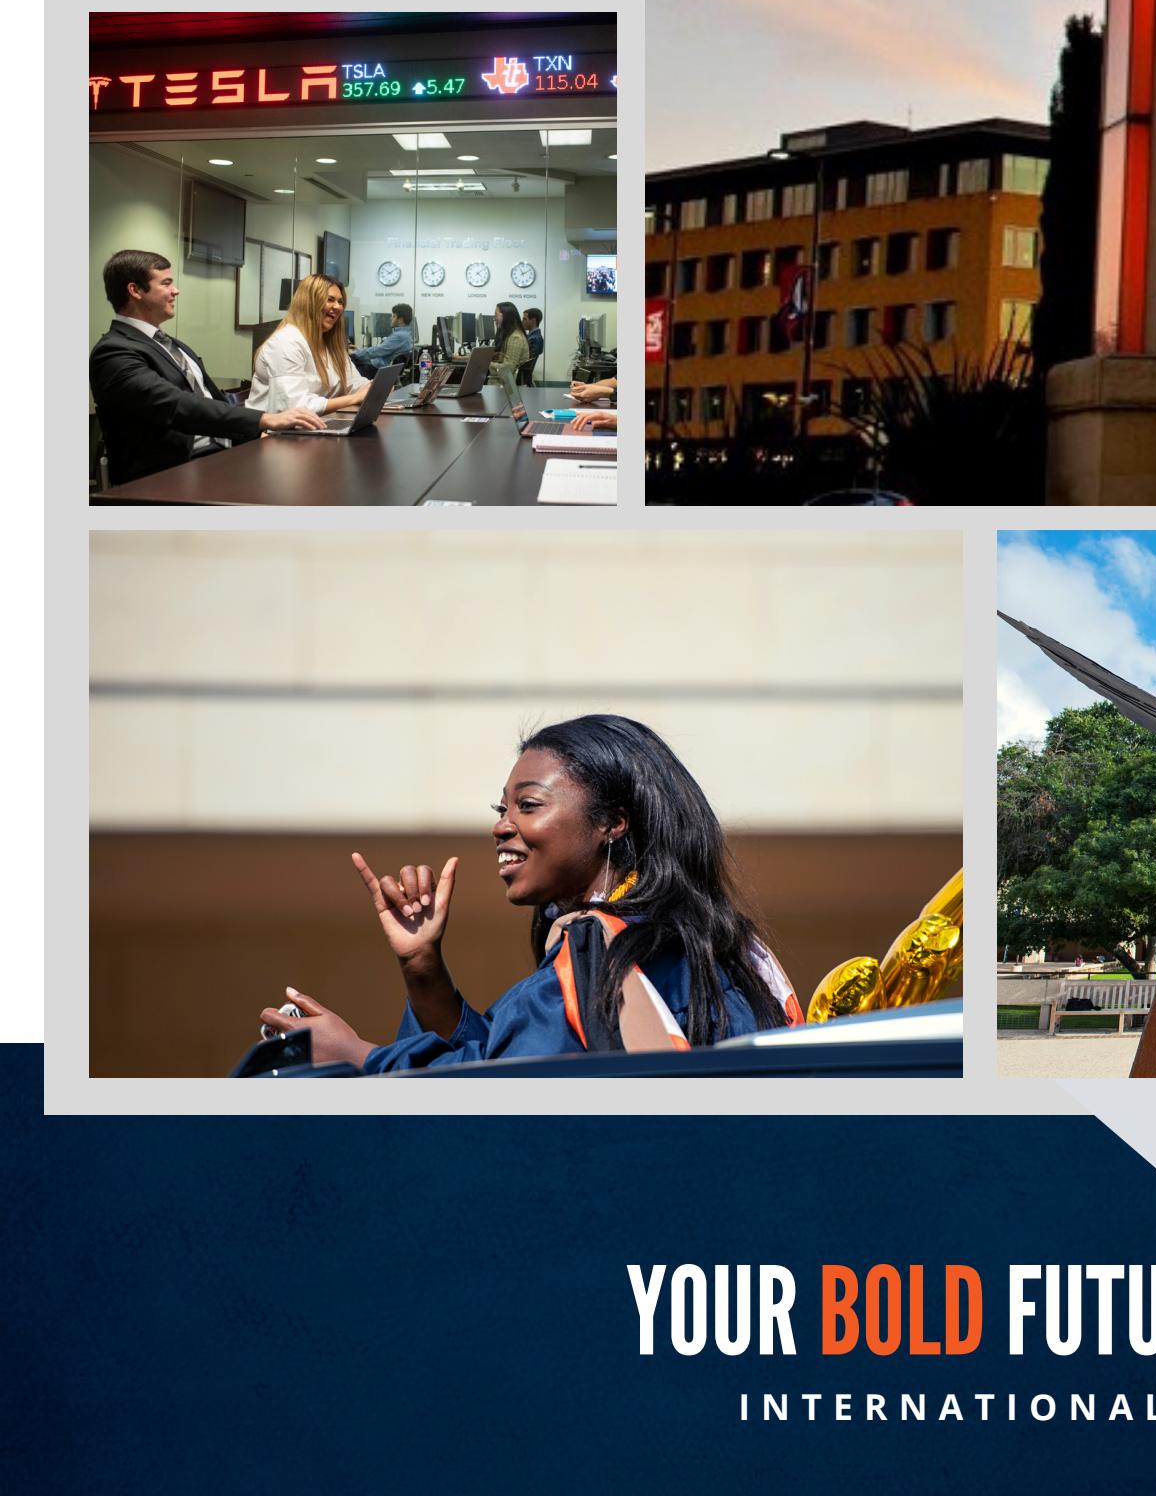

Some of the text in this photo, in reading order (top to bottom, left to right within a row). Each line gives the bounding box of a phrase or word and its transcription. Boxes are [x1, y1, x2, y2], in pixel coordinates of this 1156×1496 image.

[342, 63, 386, 80] TSLA
[533, 55, 573, 71] TXN
[119, 65, 337, 108] TESLA
[342, 78, 466, 98] 357.69 5.47
[535, 73, 599, 92] 115.04
[443, 237, 489, 251] Trading
